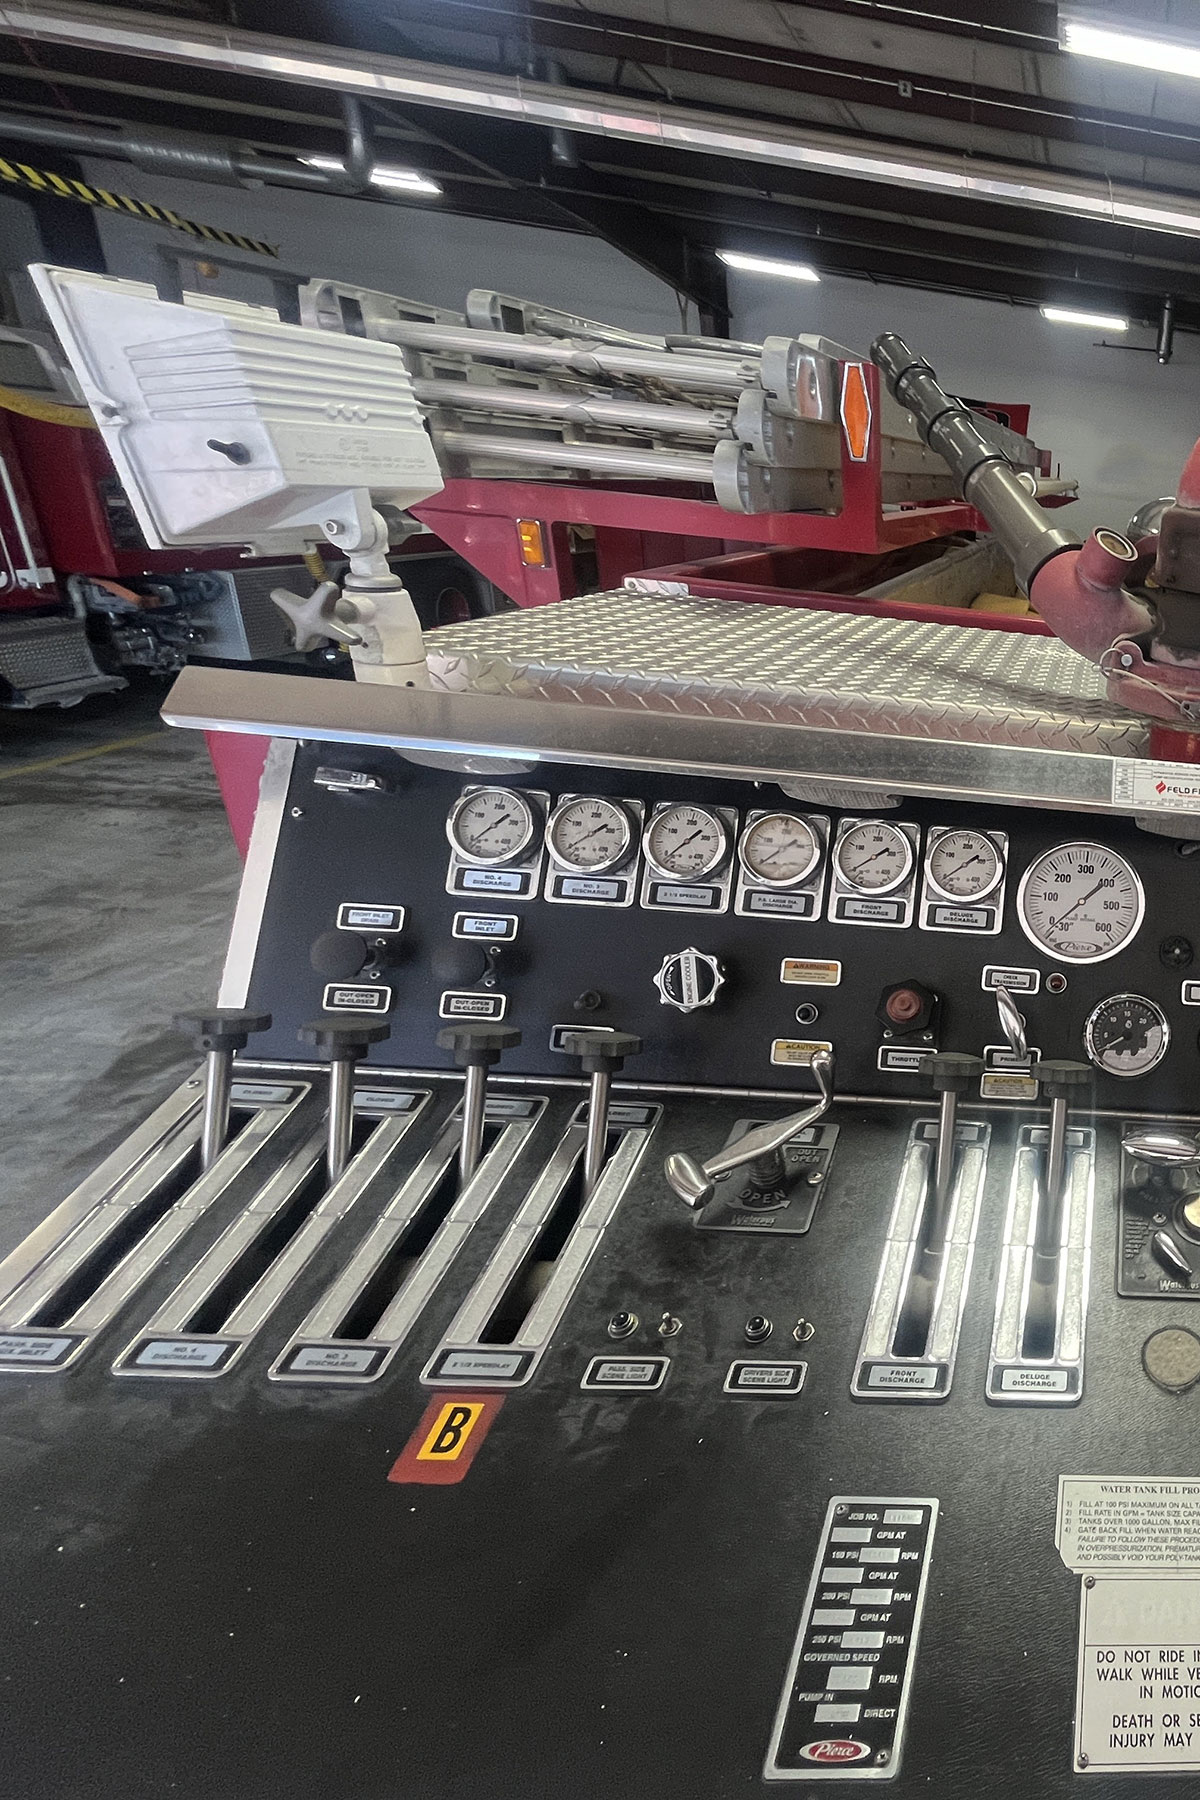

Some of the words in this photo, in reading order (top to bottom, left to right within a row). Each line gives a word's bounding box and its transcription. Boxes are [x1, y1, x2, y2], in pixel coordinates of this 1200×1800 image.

[1166, 786, 1190, 795] FELD
[1077, 863, 1095, 875] 300
[1054, 872, 1072, 884] 200
[1098, 877, 1115, 889] 400
[1042, 891, 1059, 902] 100
[1103, 900, 1120, 911] 500
[853, 909, 889, 917] DISCHARGE
[942, 916, 979, 924] DISCHARGE
[1094, 922, 1112, 933] 600
[1065, 942, 1094, 952] Pierce
[684, 956, 692, 981] COOLER
[686, 981, 695, 1004] ENGINE
[879, 1376, 925, 1384] DISCHARGE
[430, 1406, 472, 1454] B
[1101, 1485, 1131, 1493] WATER
[1134, 1486, 1158, 1494] TANK
[1160, 1486, 1180, 1494] FILL
[865, 1513, 880, 1521] NO.
[1125, 1518, 1140, 1526] 1000
[876, 1531, 895, 1540] GPM
[894, 1531, 907, 1540] AT
[1077, 1535, 1107, 1543] FAILURE
[1076, 1544, 1085, 1552] IN
[832, 1551, 846, 1559] 150
[846, 1551, 859, 1560] PSI
[901, 1552, 919, 1560] RPM
[868, 1572, 888, 1580] GPM
[887, 1572, 900, 1580] AT
[837, 1592, 850, 1600] PSI
[894, 1593, 912, 1601] RPM
[860, 1613, 880, 1622] GPM
[880, 1613, 892, 1622] AT
[828, 1635, 842, 1644] PSI
[886, 1636, 905, 1644] RPM
[803, 1653, 850, 1662] GOVERNED
[852, 1653, 880, 1662] SPEED
[1096, 1650, 1116, 1664] DO
[1123, 1650, 1151, 1664] NOT
[1158, 1650, 1185, 1663] RIDE
[878, 1674, 898, 1684] RPM
[1097, 1667, 1133, 1681] WALK
[1141, 1667, 1179, 1680] WHILE
[1139, 1685, 1153, 1699] IN
[798, 1693, 823, 1702] PUMP
[824, 1693, 834, 1702] IN
[863, 1708, 896, 1719] DIRECT
[1112, 1714, 1153, 1728] DEATH
[1162, 1714, 1181, 1728] OR
[1109, 1733, 1155, 1748] INJURY
[1164, 1732, 1193, 1747] MAY
[814, 1742, 856, 1760] Pierce
